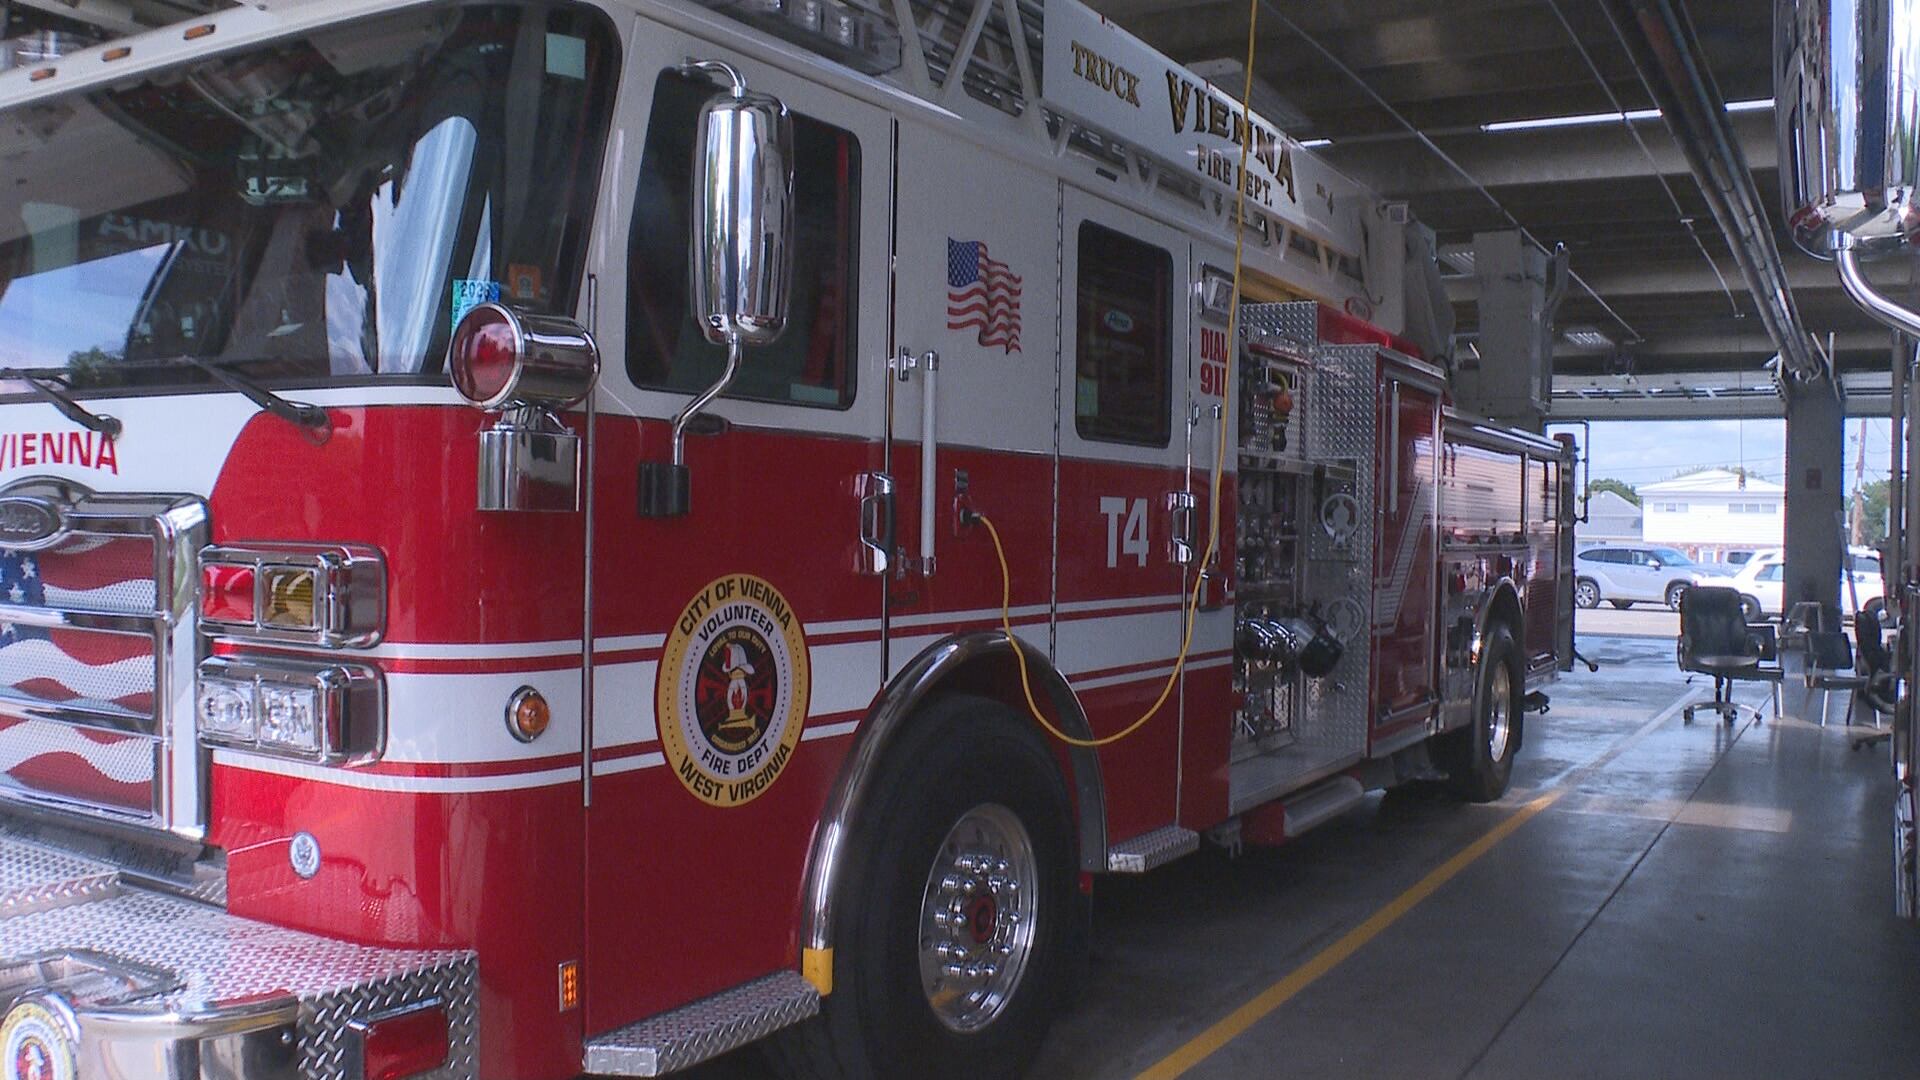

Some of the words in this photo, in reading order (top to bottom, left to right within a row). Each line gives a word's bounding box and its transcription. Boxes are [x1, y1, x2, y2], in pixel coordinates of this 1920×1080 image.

[1071, 40, 1140, 108] TRUCK
[1165, 69, 1297, 204] VIENNA
[1197, 143, 1232, 186] FIRE
[1200, 326, 1229, 363] DIAL
[1200, 362, 1226, 397] 911
[1100, 496, 1149, 568] T4
[680, 590, 711, 636] CITY
[715, 579, 735, 601] OF
[740, 577, 791, 630] VIENNA
[698, 605, 774, 642] VOLUNTEER
[679, 754, 723, 800] WEST
[729, 743, 791, 802] VIRGINIA
[701, 748, 731, 775] FIRE
[737, 738, 770, 774] DEPT
